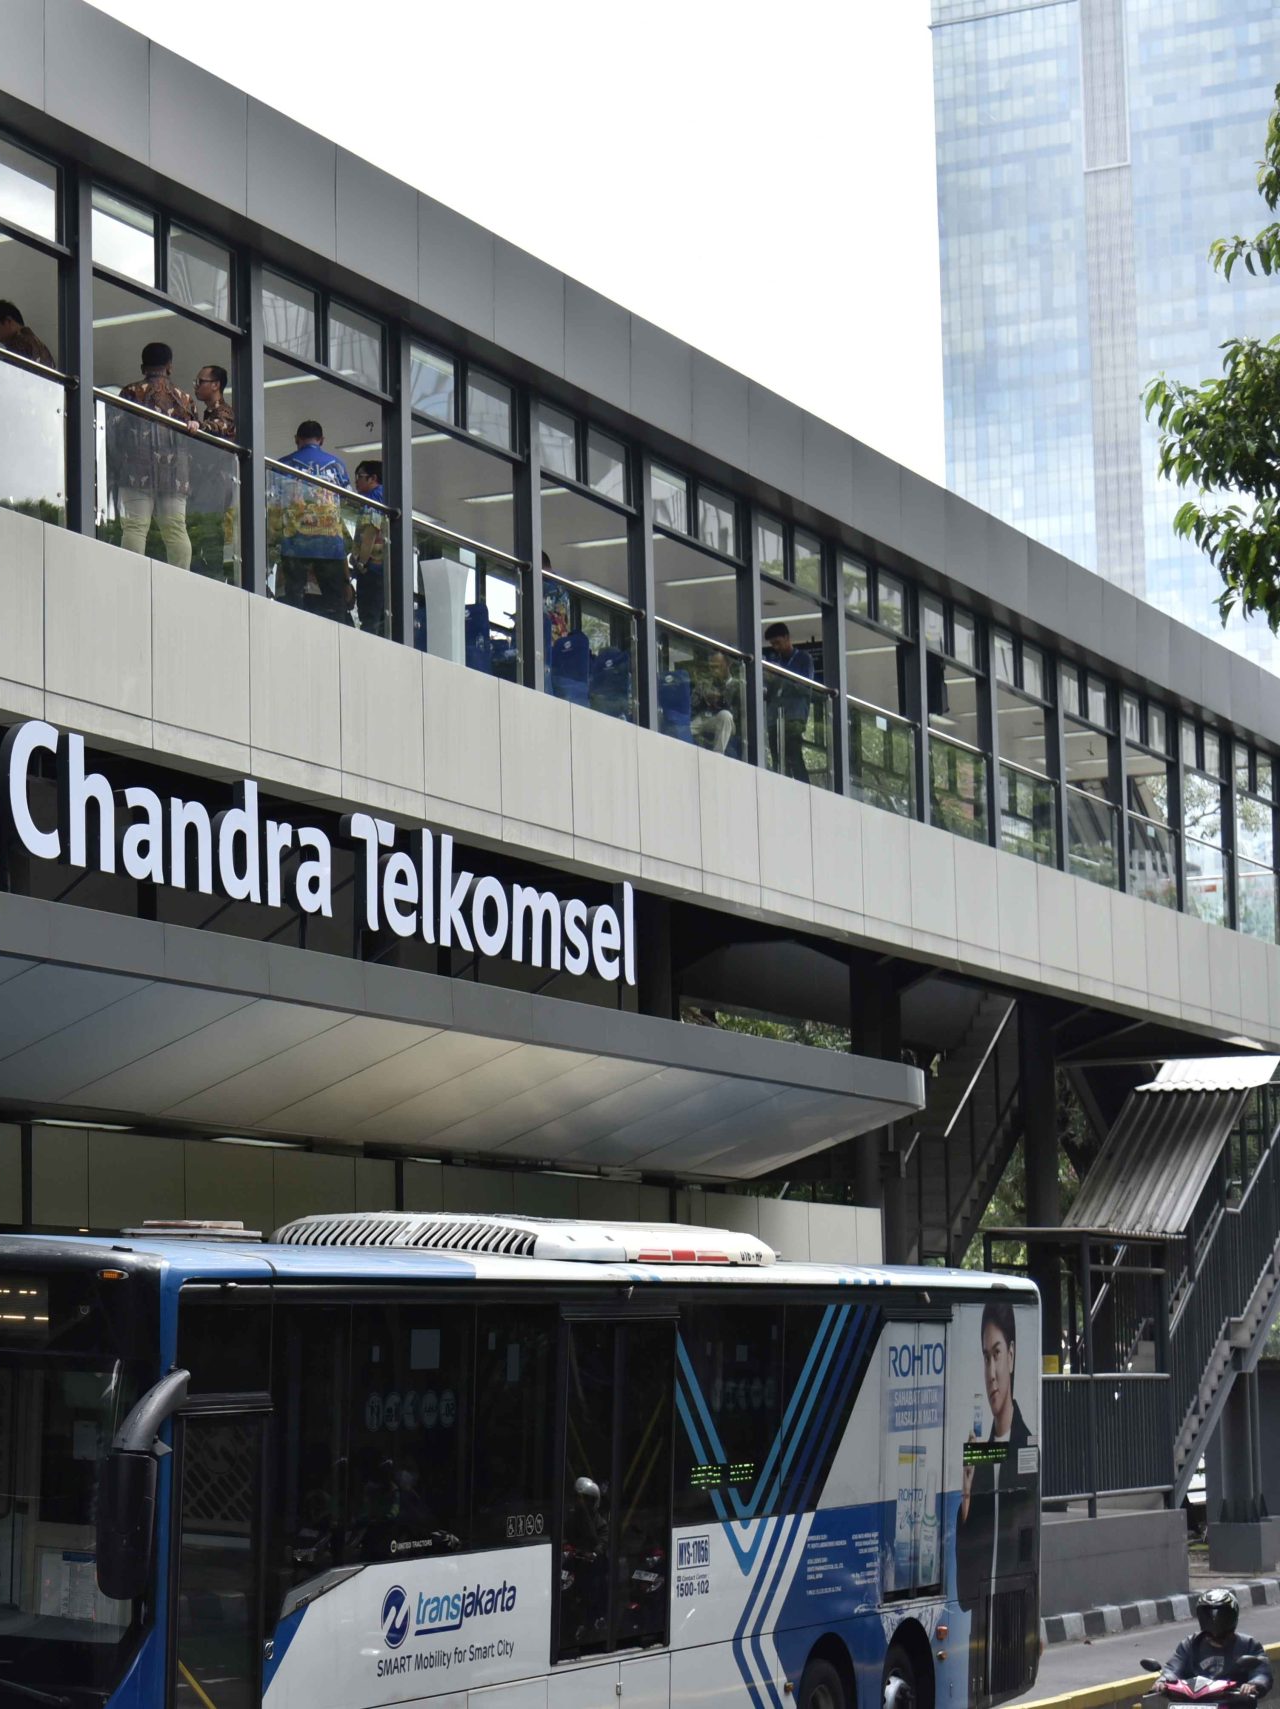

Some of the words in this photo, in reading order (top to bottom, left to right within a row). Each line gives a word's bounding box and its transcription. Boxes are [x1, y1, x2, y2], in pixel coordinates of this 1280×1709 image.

[9, 720, 333, 918] Chandra
[351, 813, 636, 986] Telkomsel
[888, 1342, 944, 1378] ROHTO
[898, 1488, 923, 1501] ROHTO
[676, 1579, 710, 1598] 1500-102
[414, 1580, 517, 1636] transjakarta
[377, 1655, 412, 1678] SMART
[414, 1650, 452, 1672] Mobility
[454, 1647, 467, 1664] for
[469, 1643, 495, 1661] Smart
[497, 1640, 515, 1659] City
